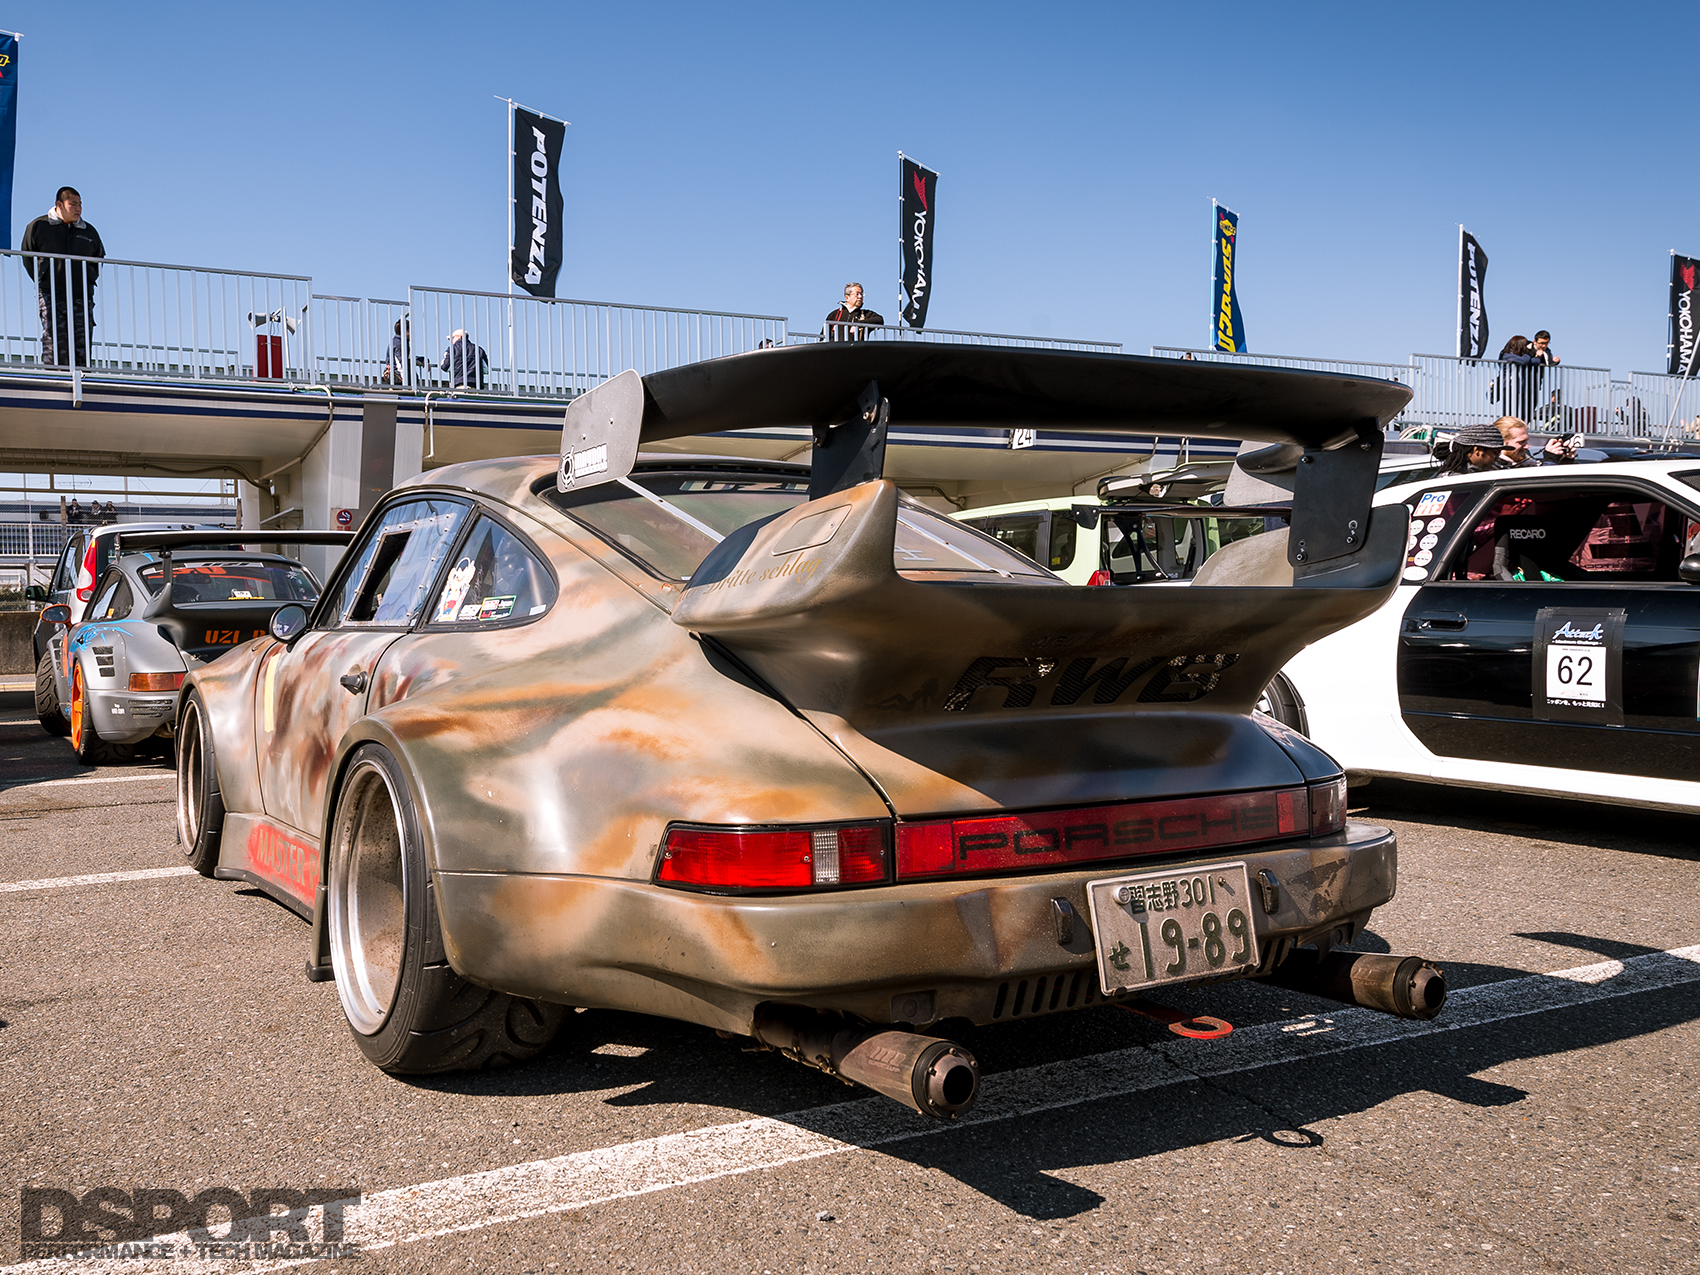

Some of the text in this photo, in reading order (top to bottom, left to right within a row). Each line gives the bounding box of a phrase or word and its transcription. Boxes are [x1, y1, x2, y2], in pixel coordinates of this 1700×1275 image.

[524, 126, 548, 285] POTENZA
[1467, 242, 1481, 357] POTENZA
[1017, 428, 1032, 446] 24
[1421, 493, 1446, 504] Pro
[1510, 528, 1546, 539] RECARO
[759, 551, 823, 584] schlag
[205, 630, 240, 644] UZI
[1552, 621, 1604, 640] Attack
[942, 653, 1241, 713] RWB
[1557, 655, 1593, 686] 62
[959, 805, 1276, 861] PORSCHE
[257, 829, 306, 886] MASTER
